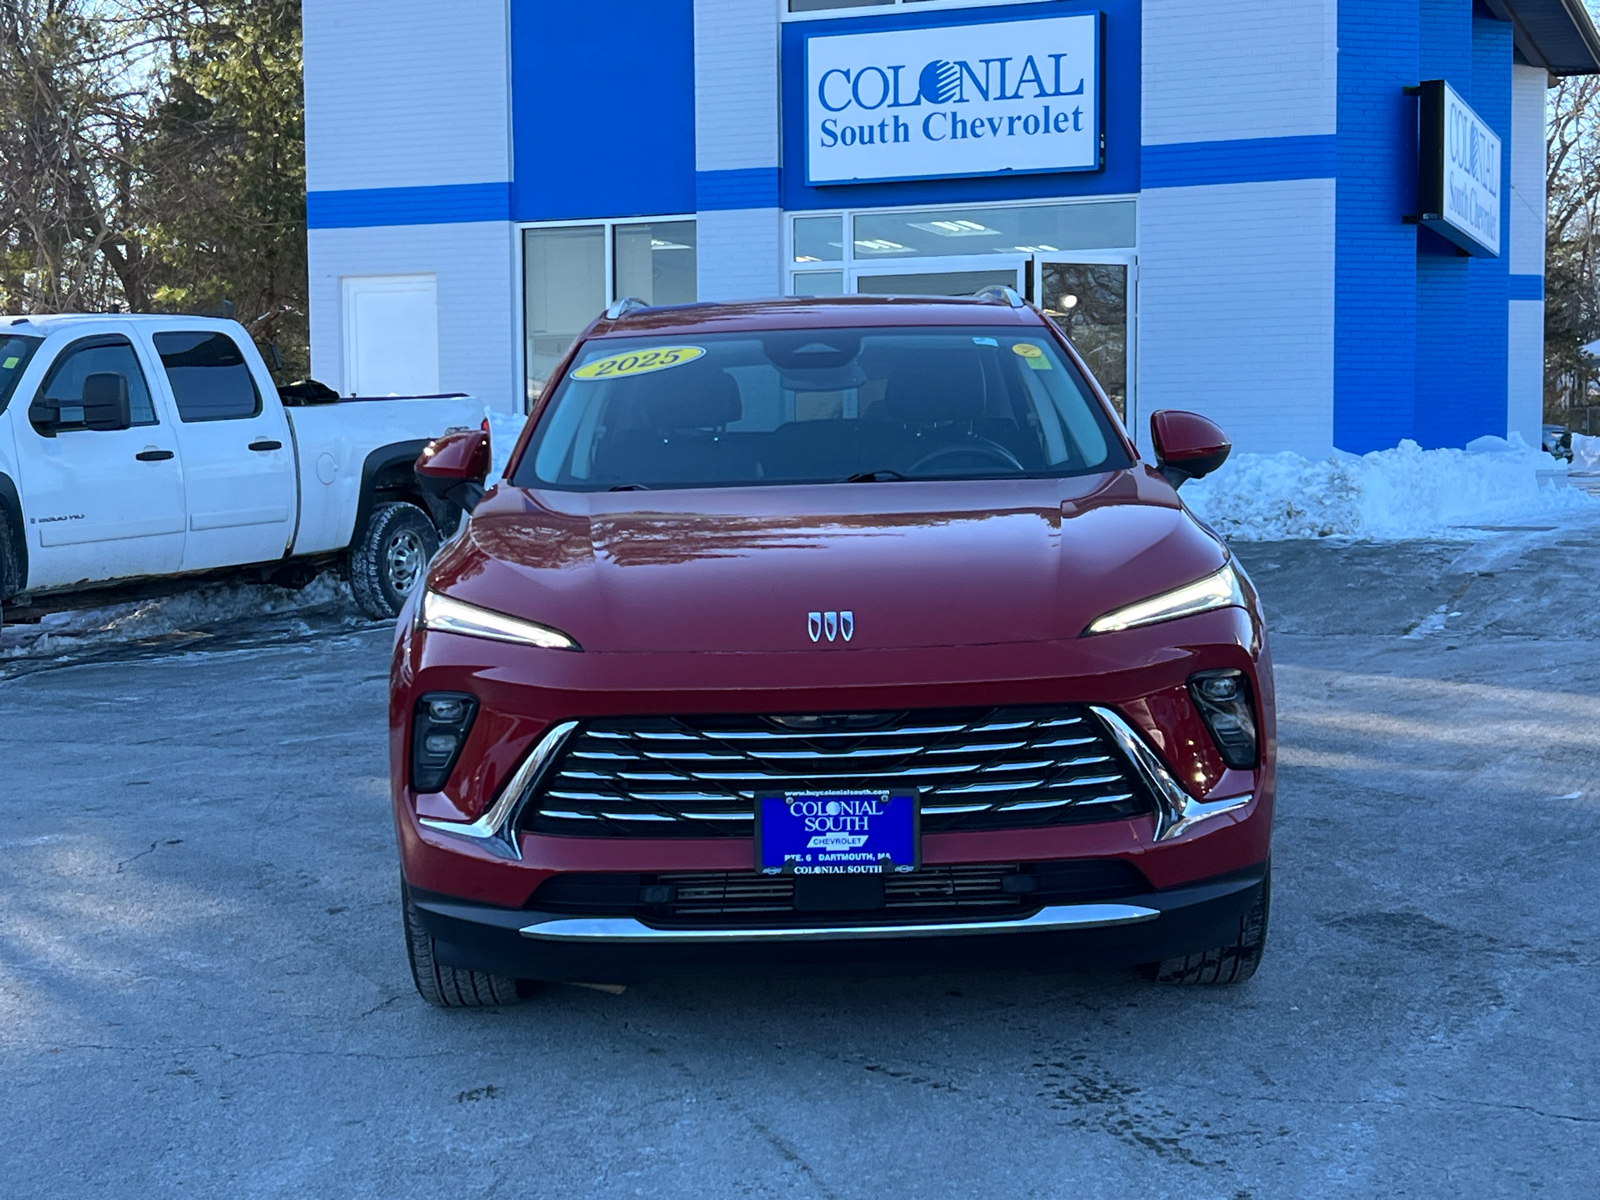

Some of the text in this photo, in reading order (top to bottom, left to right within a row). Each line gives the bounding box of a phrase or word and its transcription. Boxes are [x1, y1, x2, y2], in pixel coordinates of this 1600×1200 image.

[818, 54, 1084, 112] COLONIAL
[821, 105, 1084, 148] South Chevrolet
[1450, 103, 1498, 198] COLONIAL
[1450, 171, 1497, 242] South Chevrolet
[594, 348, 684, 377] 2025
[784, 789, 890, 797] www.buycolonialsouth.com
[790, 800, 883, 817] COLONIAL
[804, 817, 869, 832] SOUTH
[813, 837, 862, 845] CHEVROLET
[806, 854, 812, 862] 6
[818, 853, 876, 862] DARTMOUTH,
[877, 852, 892, 861] MA
[794, 865, 883, 874] COLONIAL SOUTH
